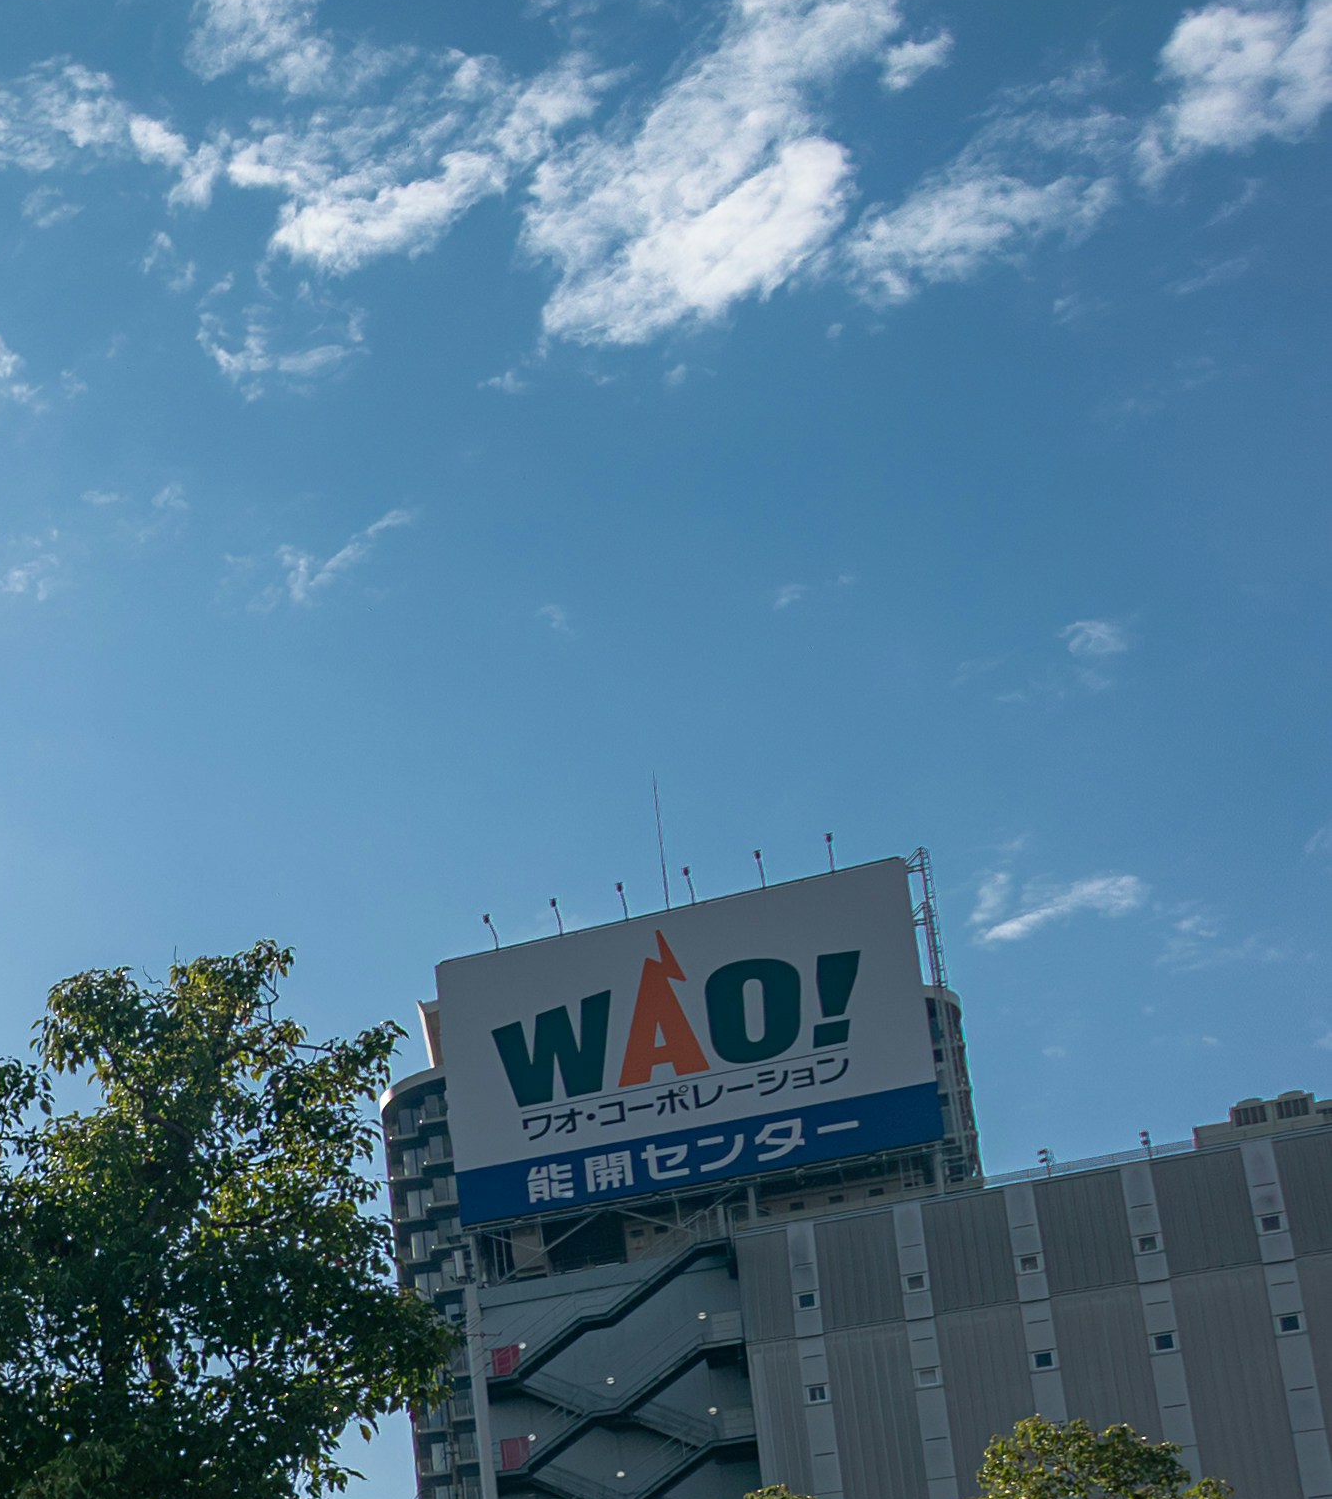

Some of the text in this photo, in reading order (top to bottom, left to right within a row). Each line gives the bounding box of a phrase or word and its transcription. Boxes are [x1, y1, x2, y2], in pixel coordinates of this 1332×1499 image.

[491, 929, 861, 1108] WAO!
[521, 1056, 850, 1141] ワオ・コーポレーション
[526, 1117, 860, 1204] 能開センター
